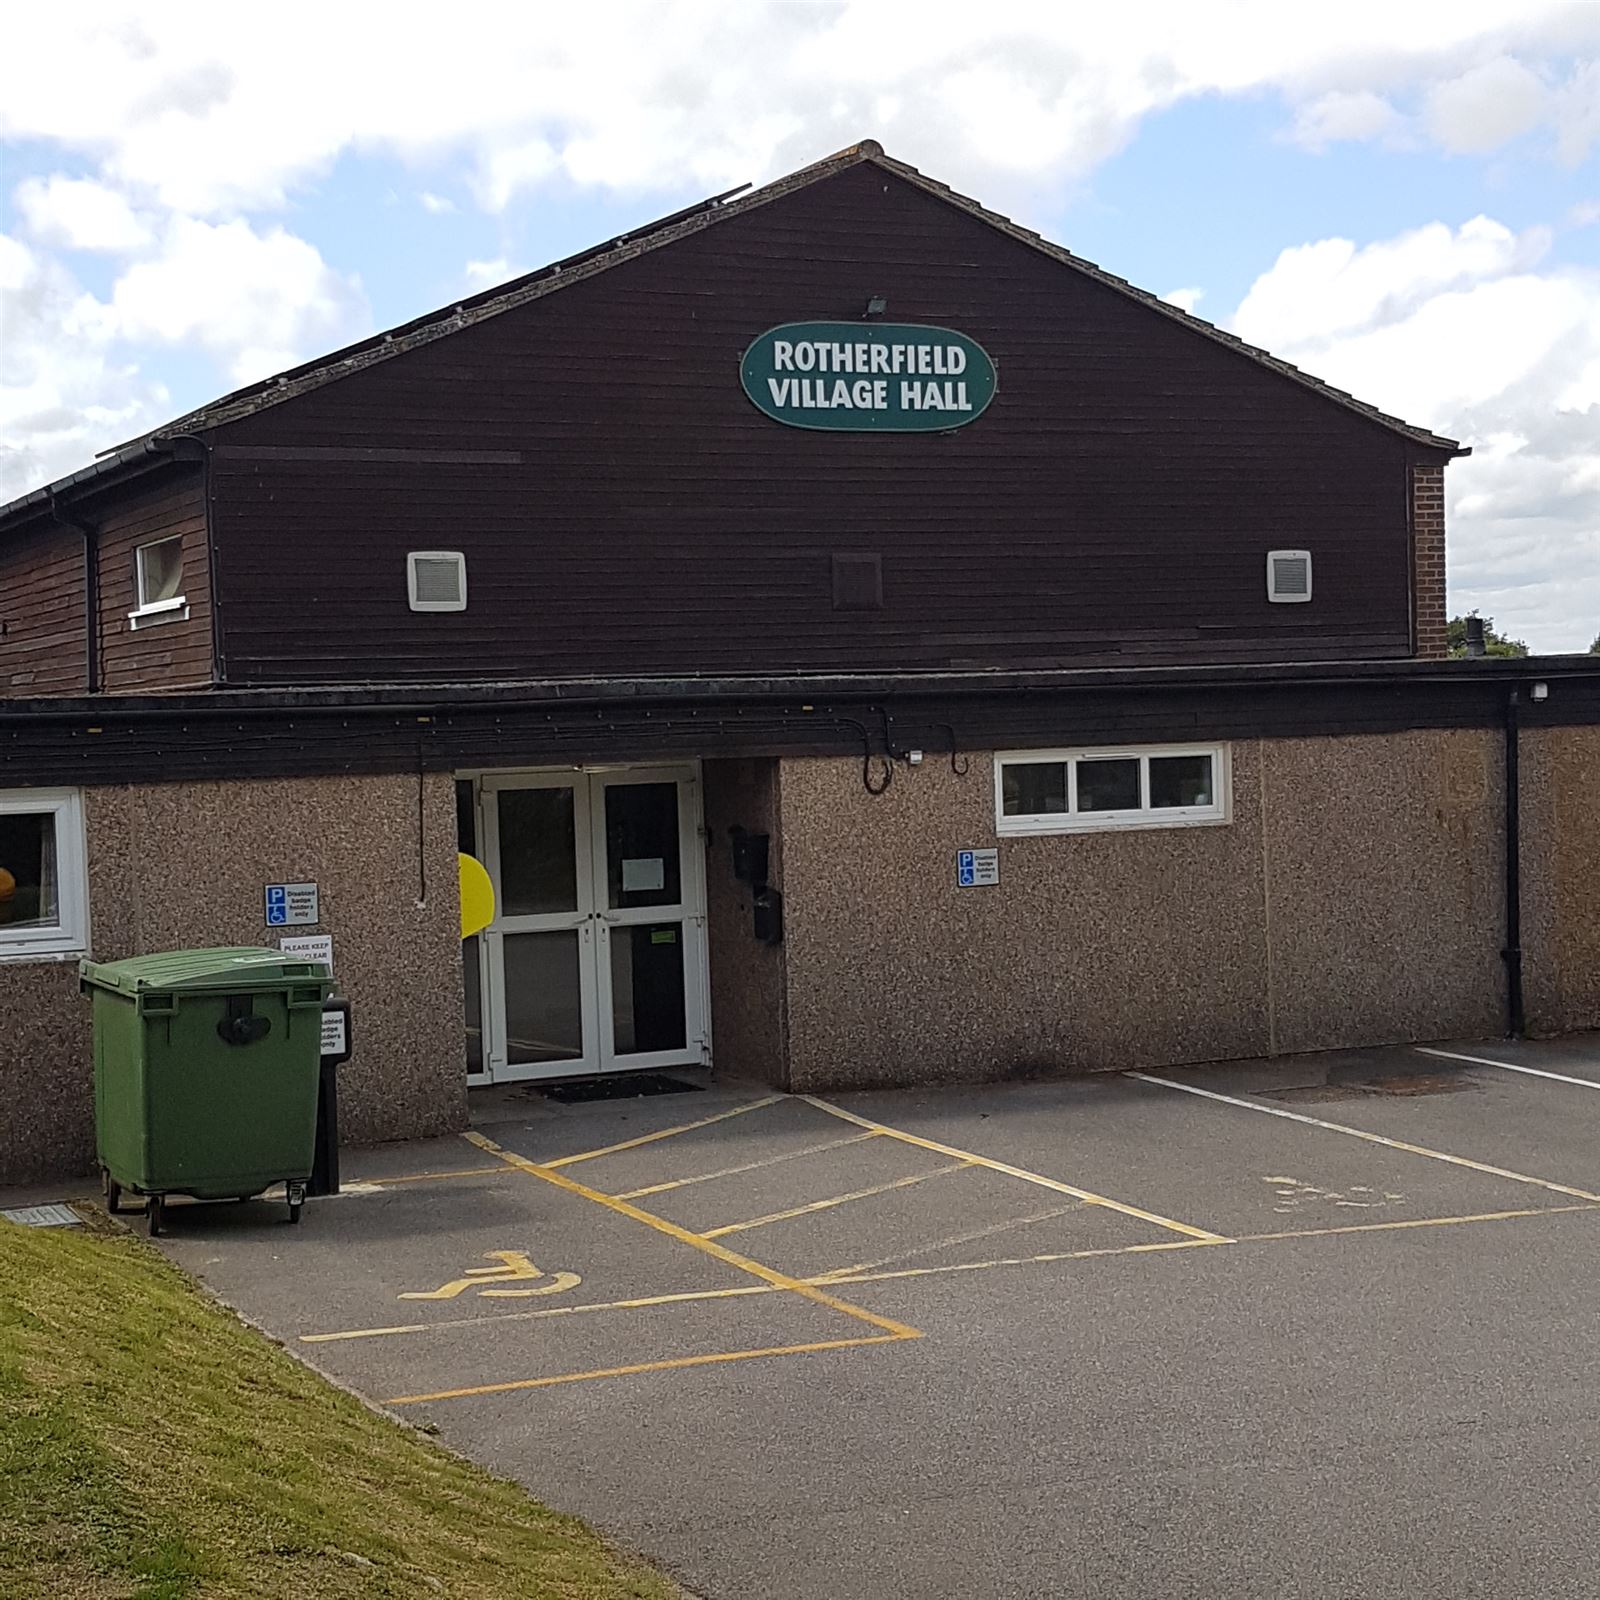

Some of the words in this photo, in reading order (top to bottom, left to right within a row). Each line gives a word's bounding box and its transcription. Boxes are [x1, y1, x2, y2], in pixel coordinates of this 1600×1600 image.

[773, 340, 967, 376] ROTHERFIELD
[767, 377, 888, 409] VILLAGE
[900, 380, 973, 411] HALL
[271, 888, 283, 903] P
[284, 944, 310, 952] PLEASE
[311, 942, 329, 950] KEEP
